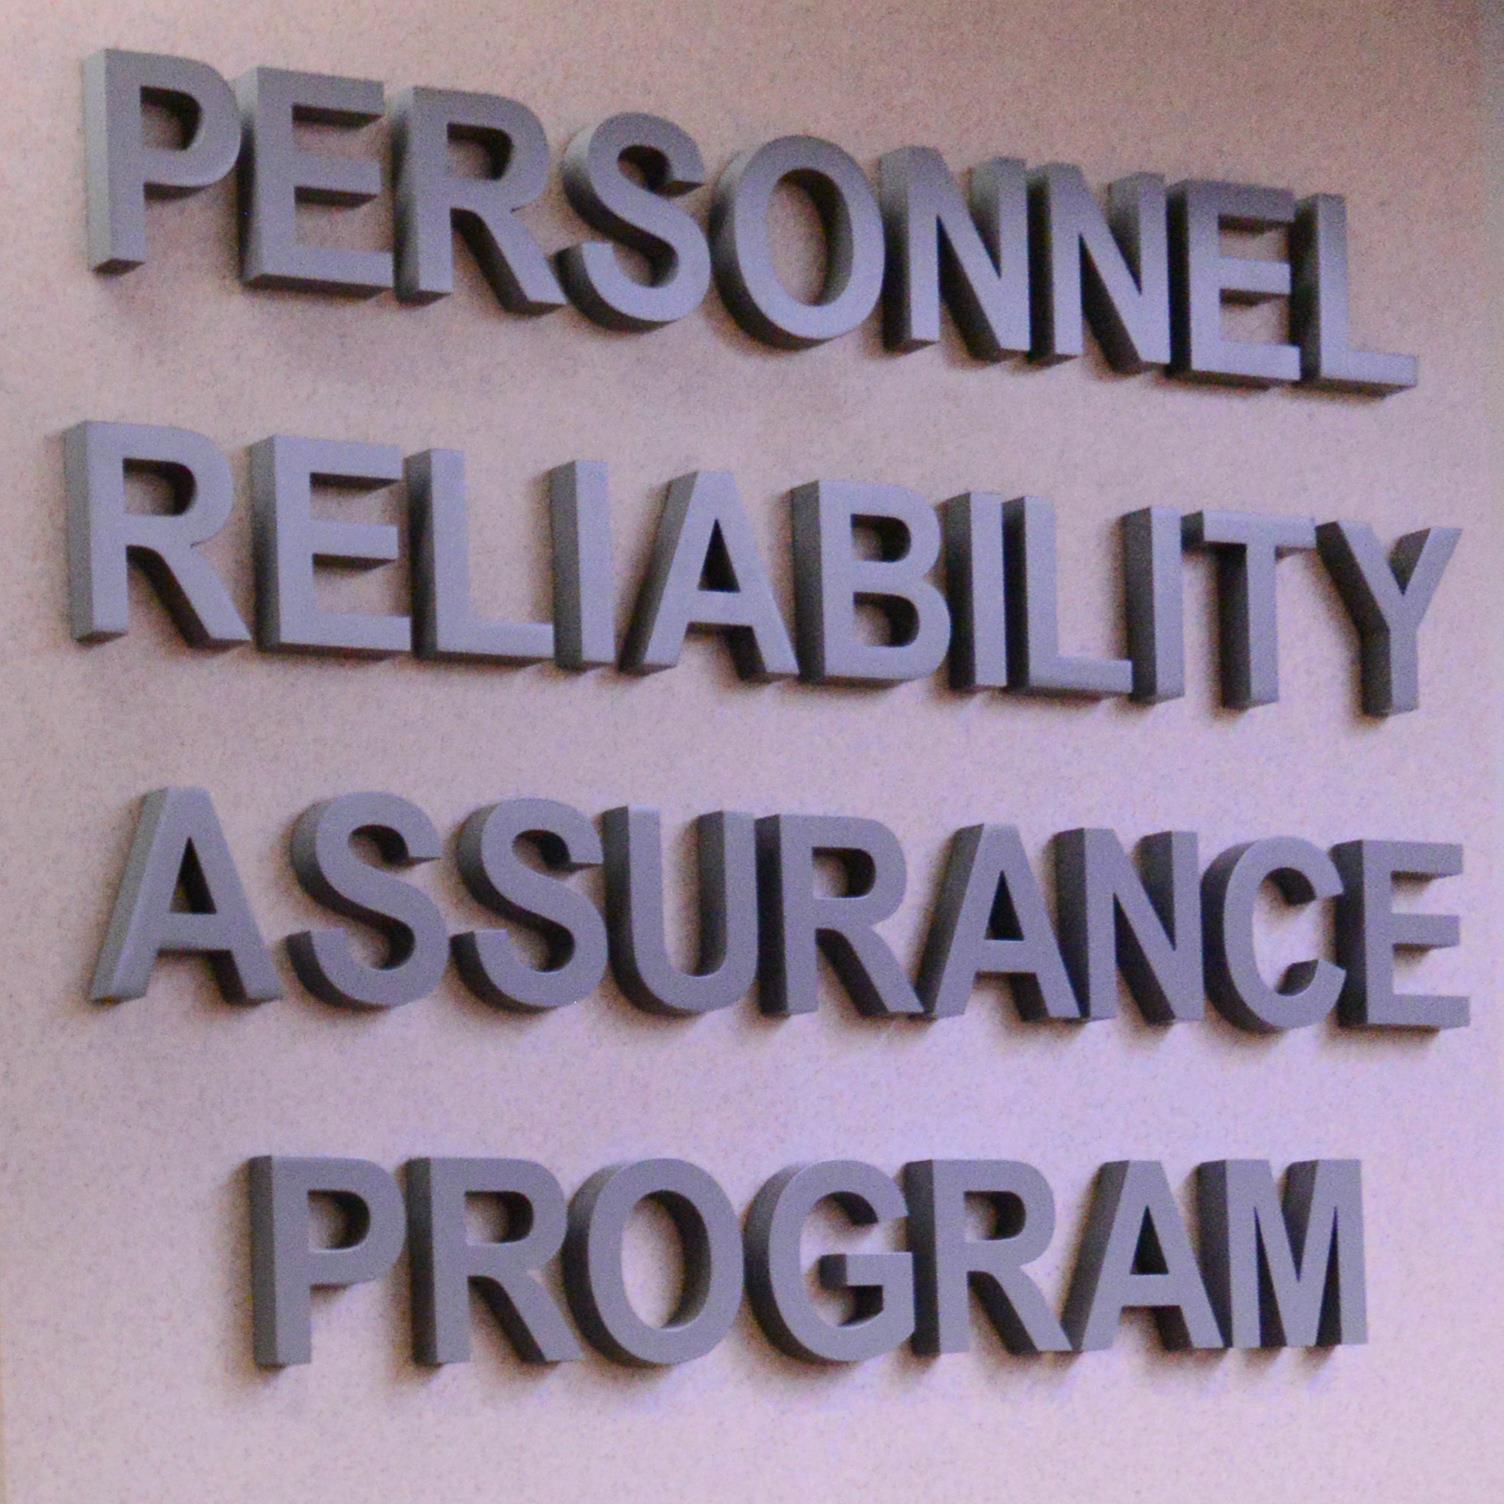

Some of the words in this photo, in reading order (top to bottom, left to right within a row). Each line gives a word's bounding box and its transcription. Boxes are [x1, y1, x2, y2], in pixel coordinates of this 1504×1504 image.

[83, 47, 1419, 397] PERSONNEL
[63, 419, 1463, 717] RELIABILITY
[89, 785, 1471, 1032] ASSURANCE
[250, 1154, 1368, 1367] PROGRAM
